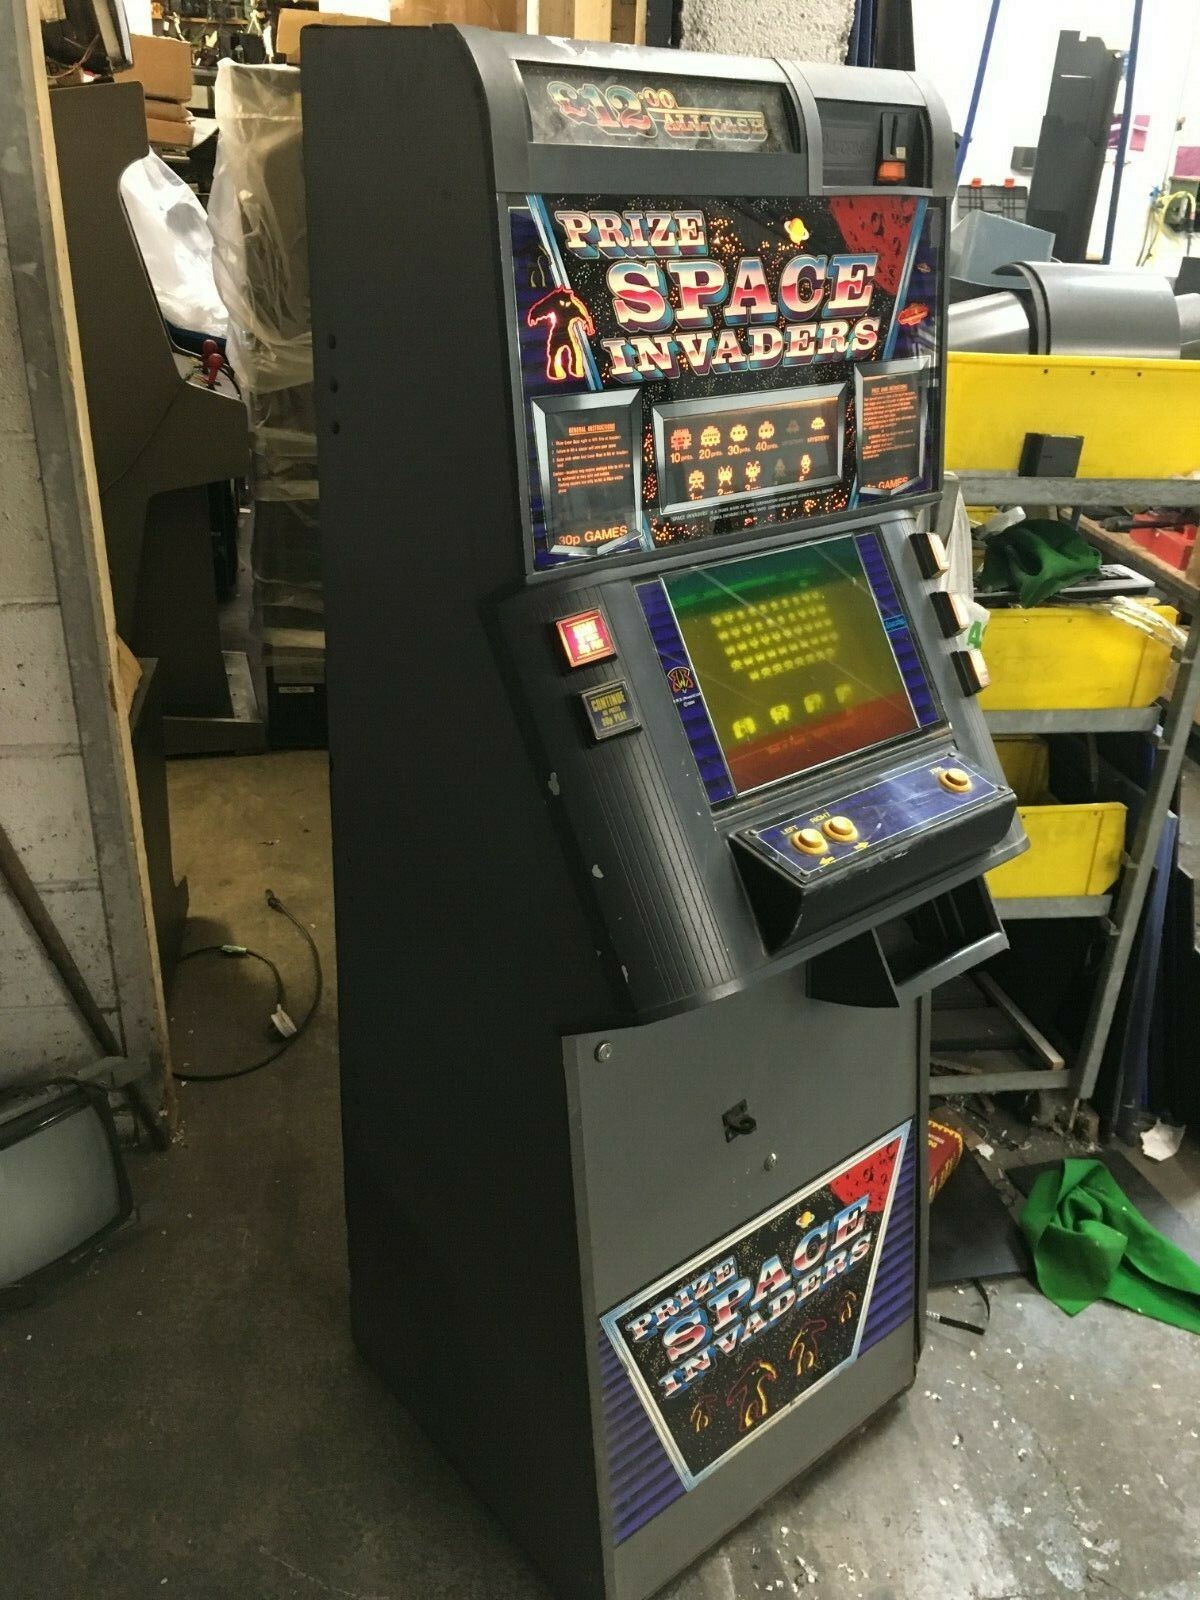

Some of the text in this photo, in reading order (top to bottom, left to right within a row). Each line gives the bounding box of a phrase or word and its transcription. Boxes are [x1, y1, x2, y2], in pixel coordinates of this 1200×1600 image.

[555, 210, 709, 258] PRIZE
[606, 254, 879, 332] SPACE
[602, 317, 882, 382] INVADERS
[584, 525, 628, 542] GAMES
[780, 824, 799, 836] LEFT
[809, 811, 831, 824] RIGHT
[625, 1255, 739, 1343] PRIZE
[662, 1194, 870, 1363] SPACE
[658, 1232, 872, 1399] INVADERS
